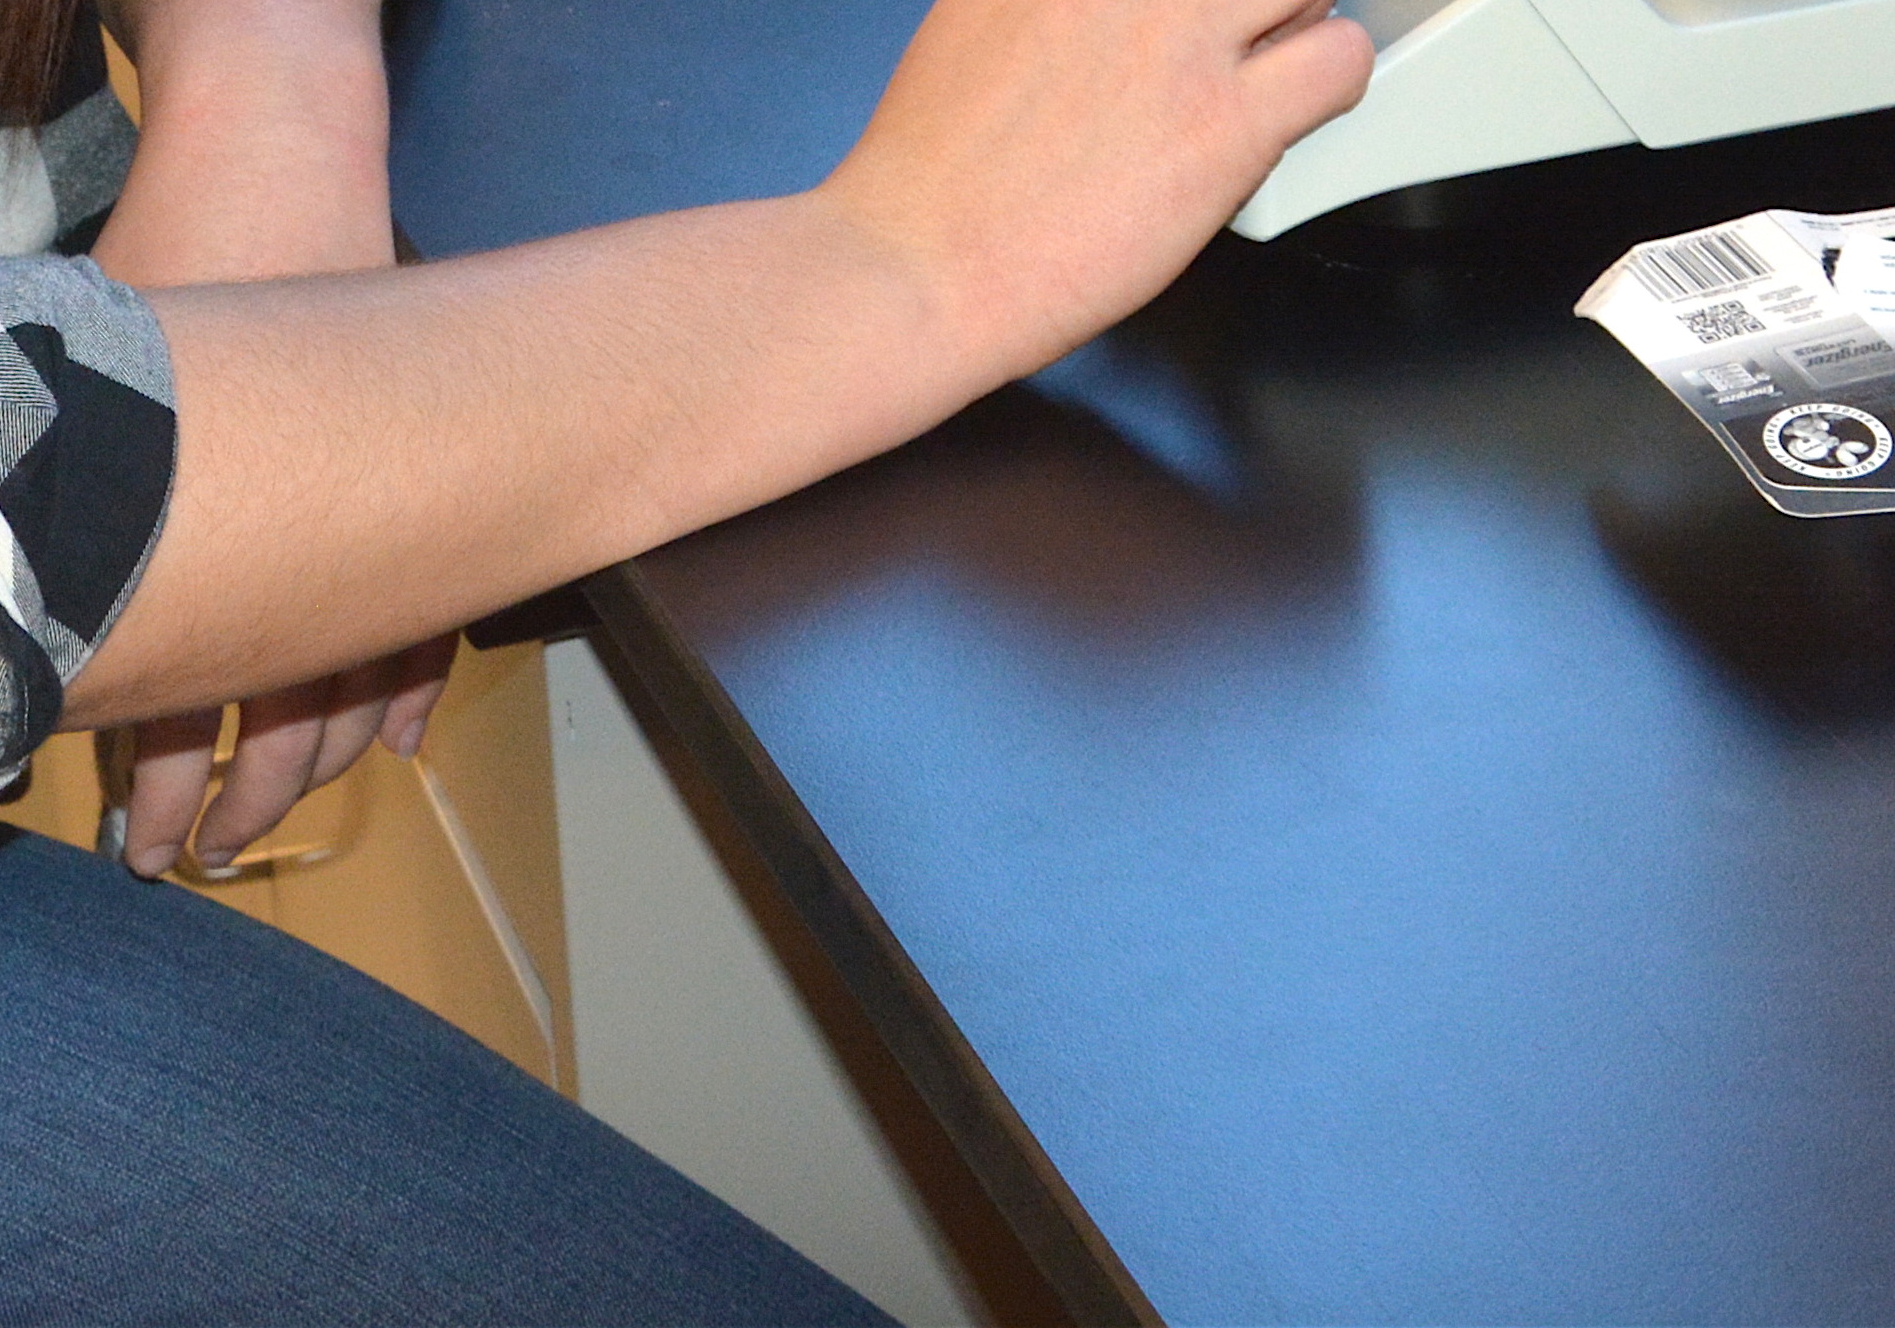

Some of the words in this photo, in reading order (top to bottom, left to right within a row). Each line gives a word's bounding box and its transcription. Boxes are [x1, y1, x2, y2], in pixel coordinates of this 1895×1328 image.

[1806, 341, 1893, 367] Energizer
[1789, 403, 1823, 415] KEEP
[1831, 405, 1876, 424] GOING
